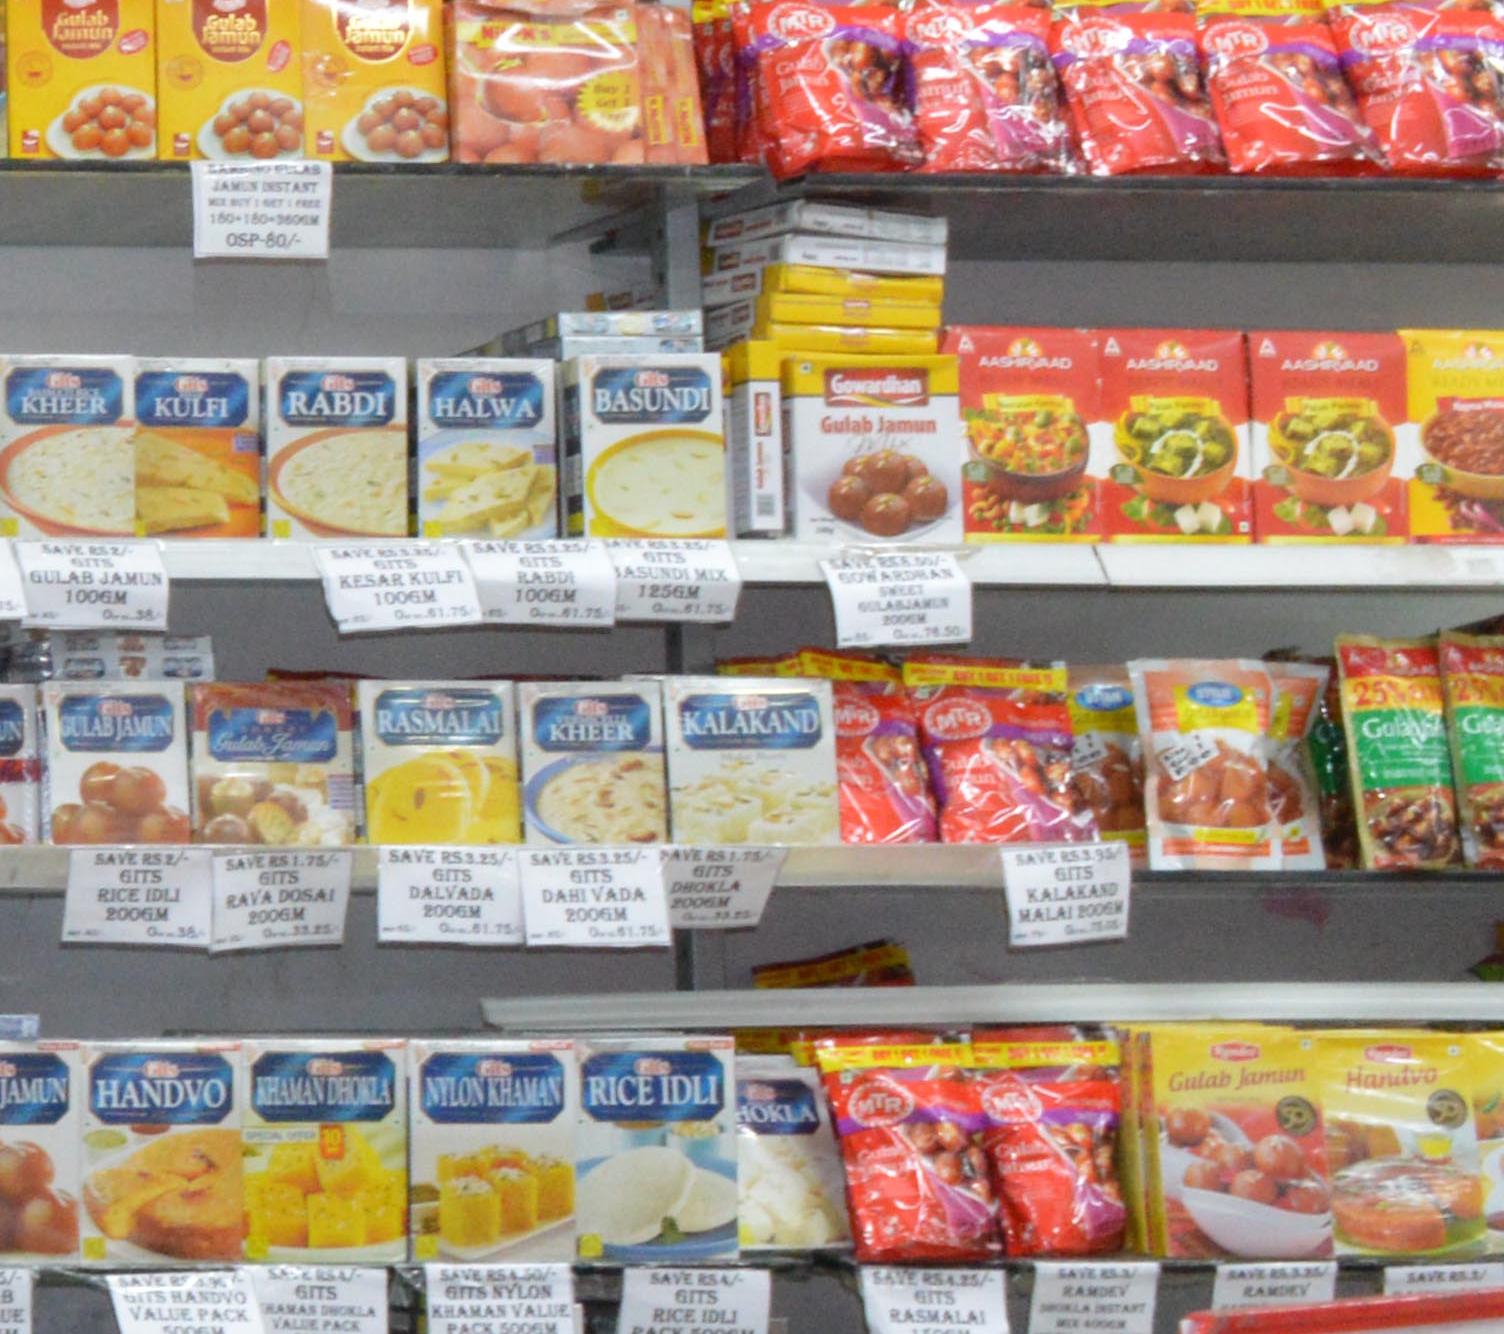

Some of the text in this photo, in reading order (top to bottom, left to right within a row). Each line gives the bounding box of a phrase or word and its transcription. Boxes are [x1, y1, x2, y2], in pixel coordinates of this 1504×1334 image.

[55, 10, 109, 27] Gulab
[780, 11, 826, 32] MTR
[830, 374, 922, 396] Gowardhan
[21, 394, 108, 416] KHEER
[154, 398, 229, 419] KULFI
[289, 393, 387, 416] RABDI
[435, 396, 535, 419] HALWA
[594, 388, 711, 414] BASUNDI
[820, 415, 937, 435] Gulab Jamun
[339, 571, 463, 589] KESAR KULFI
[378, 709, 502, 735] RASMALAI
[684, 709, 820, 736] KALAKAND
[549, 724, 635, 743] KHEER
[408, 886, 495, 902] DALVADA
[542, 888, 646, 903] DAHI VADA
[670, 879, 742, 894] DHOKLA
[226, 889, 336, 908] RAVA DOSAI
[1168, 1066, 1306, 1091] Gulab Jamun
[1346, 1066, 1438, 1091] Handvo
[96, 1079, 227, 1110] HANDVO
[590, 1074, 718, 1106] RICE IDLI
[889, 1310, 988, 1327] RASMALAI
